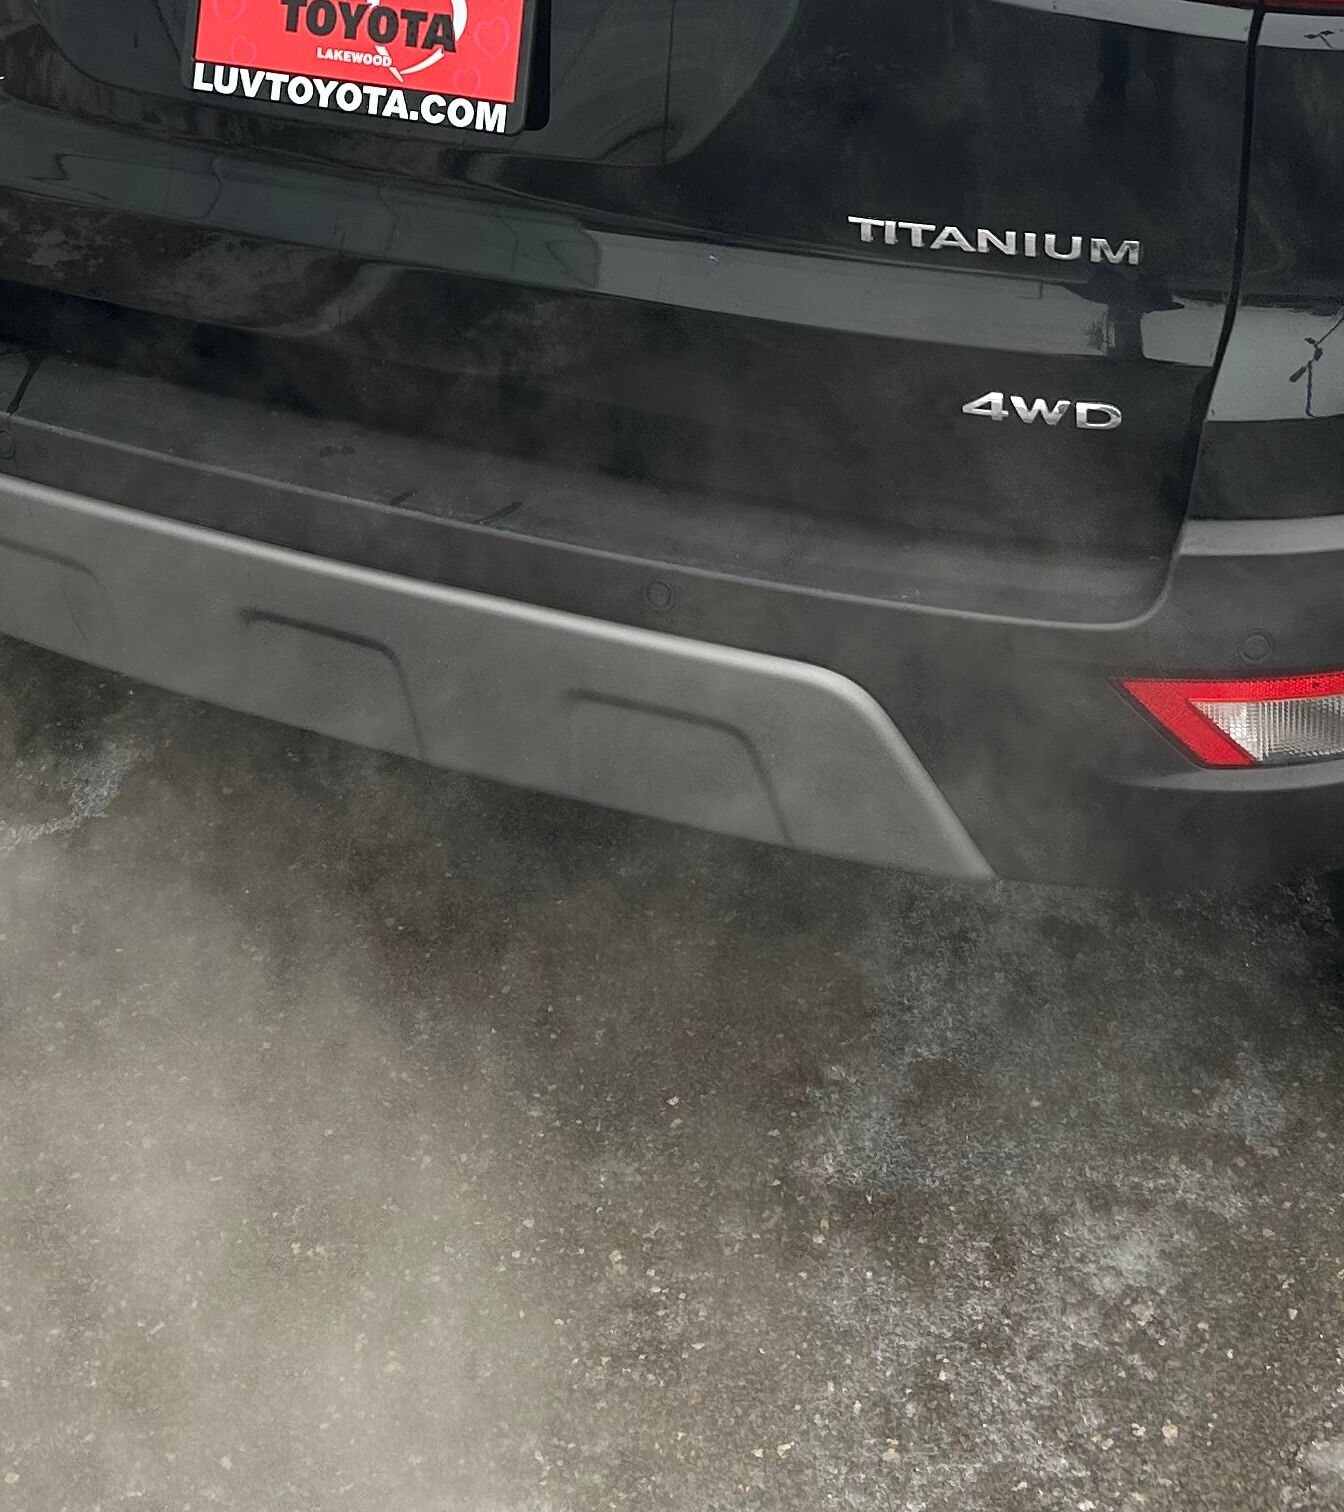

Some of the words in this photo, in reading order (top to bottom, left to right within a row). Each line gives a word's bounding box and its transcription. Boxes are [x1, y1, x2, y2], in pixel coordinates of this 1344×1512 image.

[316, 46, 393, 68] LAKEWOOD
[192, 62, 508, 134] LUVTOYOTA.COM
[847, 215, 1142, 265] TITANIUM
[962, 391, 1123, 430] 4WD
